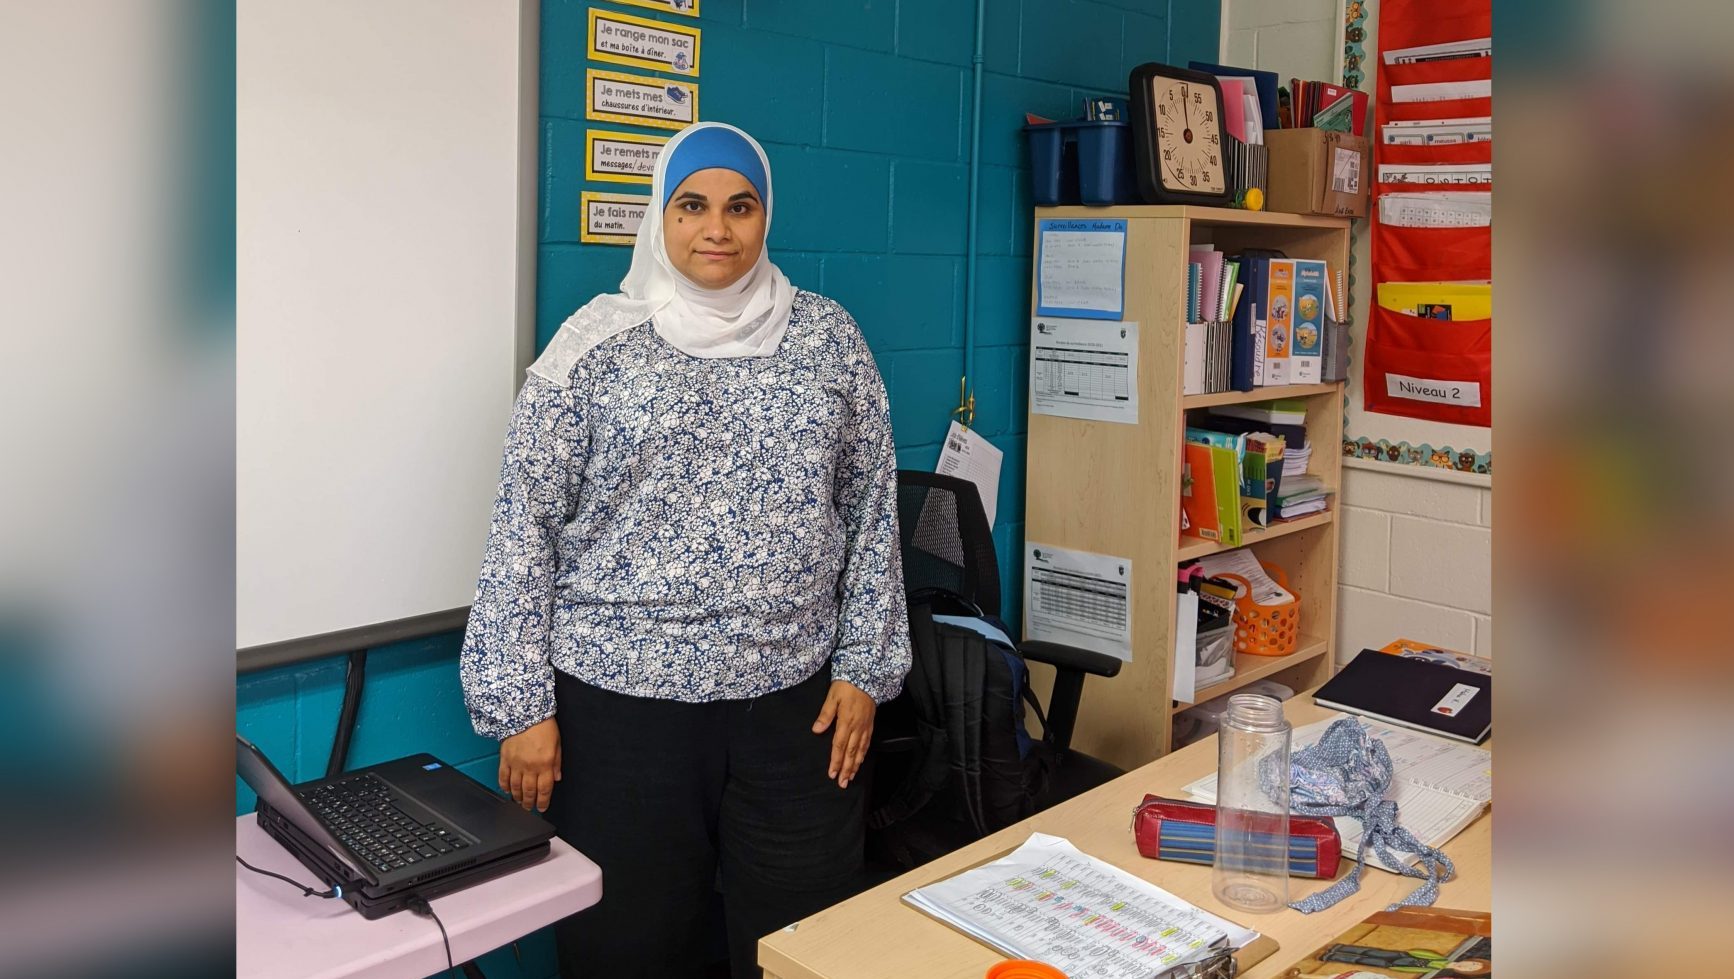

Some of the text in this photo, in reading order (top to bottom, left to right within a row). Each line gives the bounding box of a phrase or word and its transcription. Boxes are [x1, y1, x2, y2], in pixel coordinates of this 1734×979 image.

[601, 24, 689, 48] Je range mon sac
[601, 40, 608, 48] et
[622, 43, 639, 54] boîte
[601, 85, 663, 103] Je mets mes
[1169, 90, 1174, 101] 5
[1194, 92, 1202, 104] 55
[601, 99, 639, 111] chaussures
[1158, 104, 1166, 116] 10
[1205, 111, 1213, 122] 50
[1157, 127, 1165, 138] 15
[1211, 134, 1219, 145] 45
[600, 144, 612, 155] Je
[615, 148, 650, 159] remets
[1163, 149, 1172, 161] 20
[637, 161, 655, 172] devo
[1210, 155, 1217, 167] 40
[1176, 168, 1185, 180] 25
[1202, 171, 1210, 183] 35
[1190, 175, 1198, 187] 30
[593, 206, 645, 219] Je fais mo
[594, 220, 602, 228] du
[1400, 381, 1461, 399] Niveau 2
